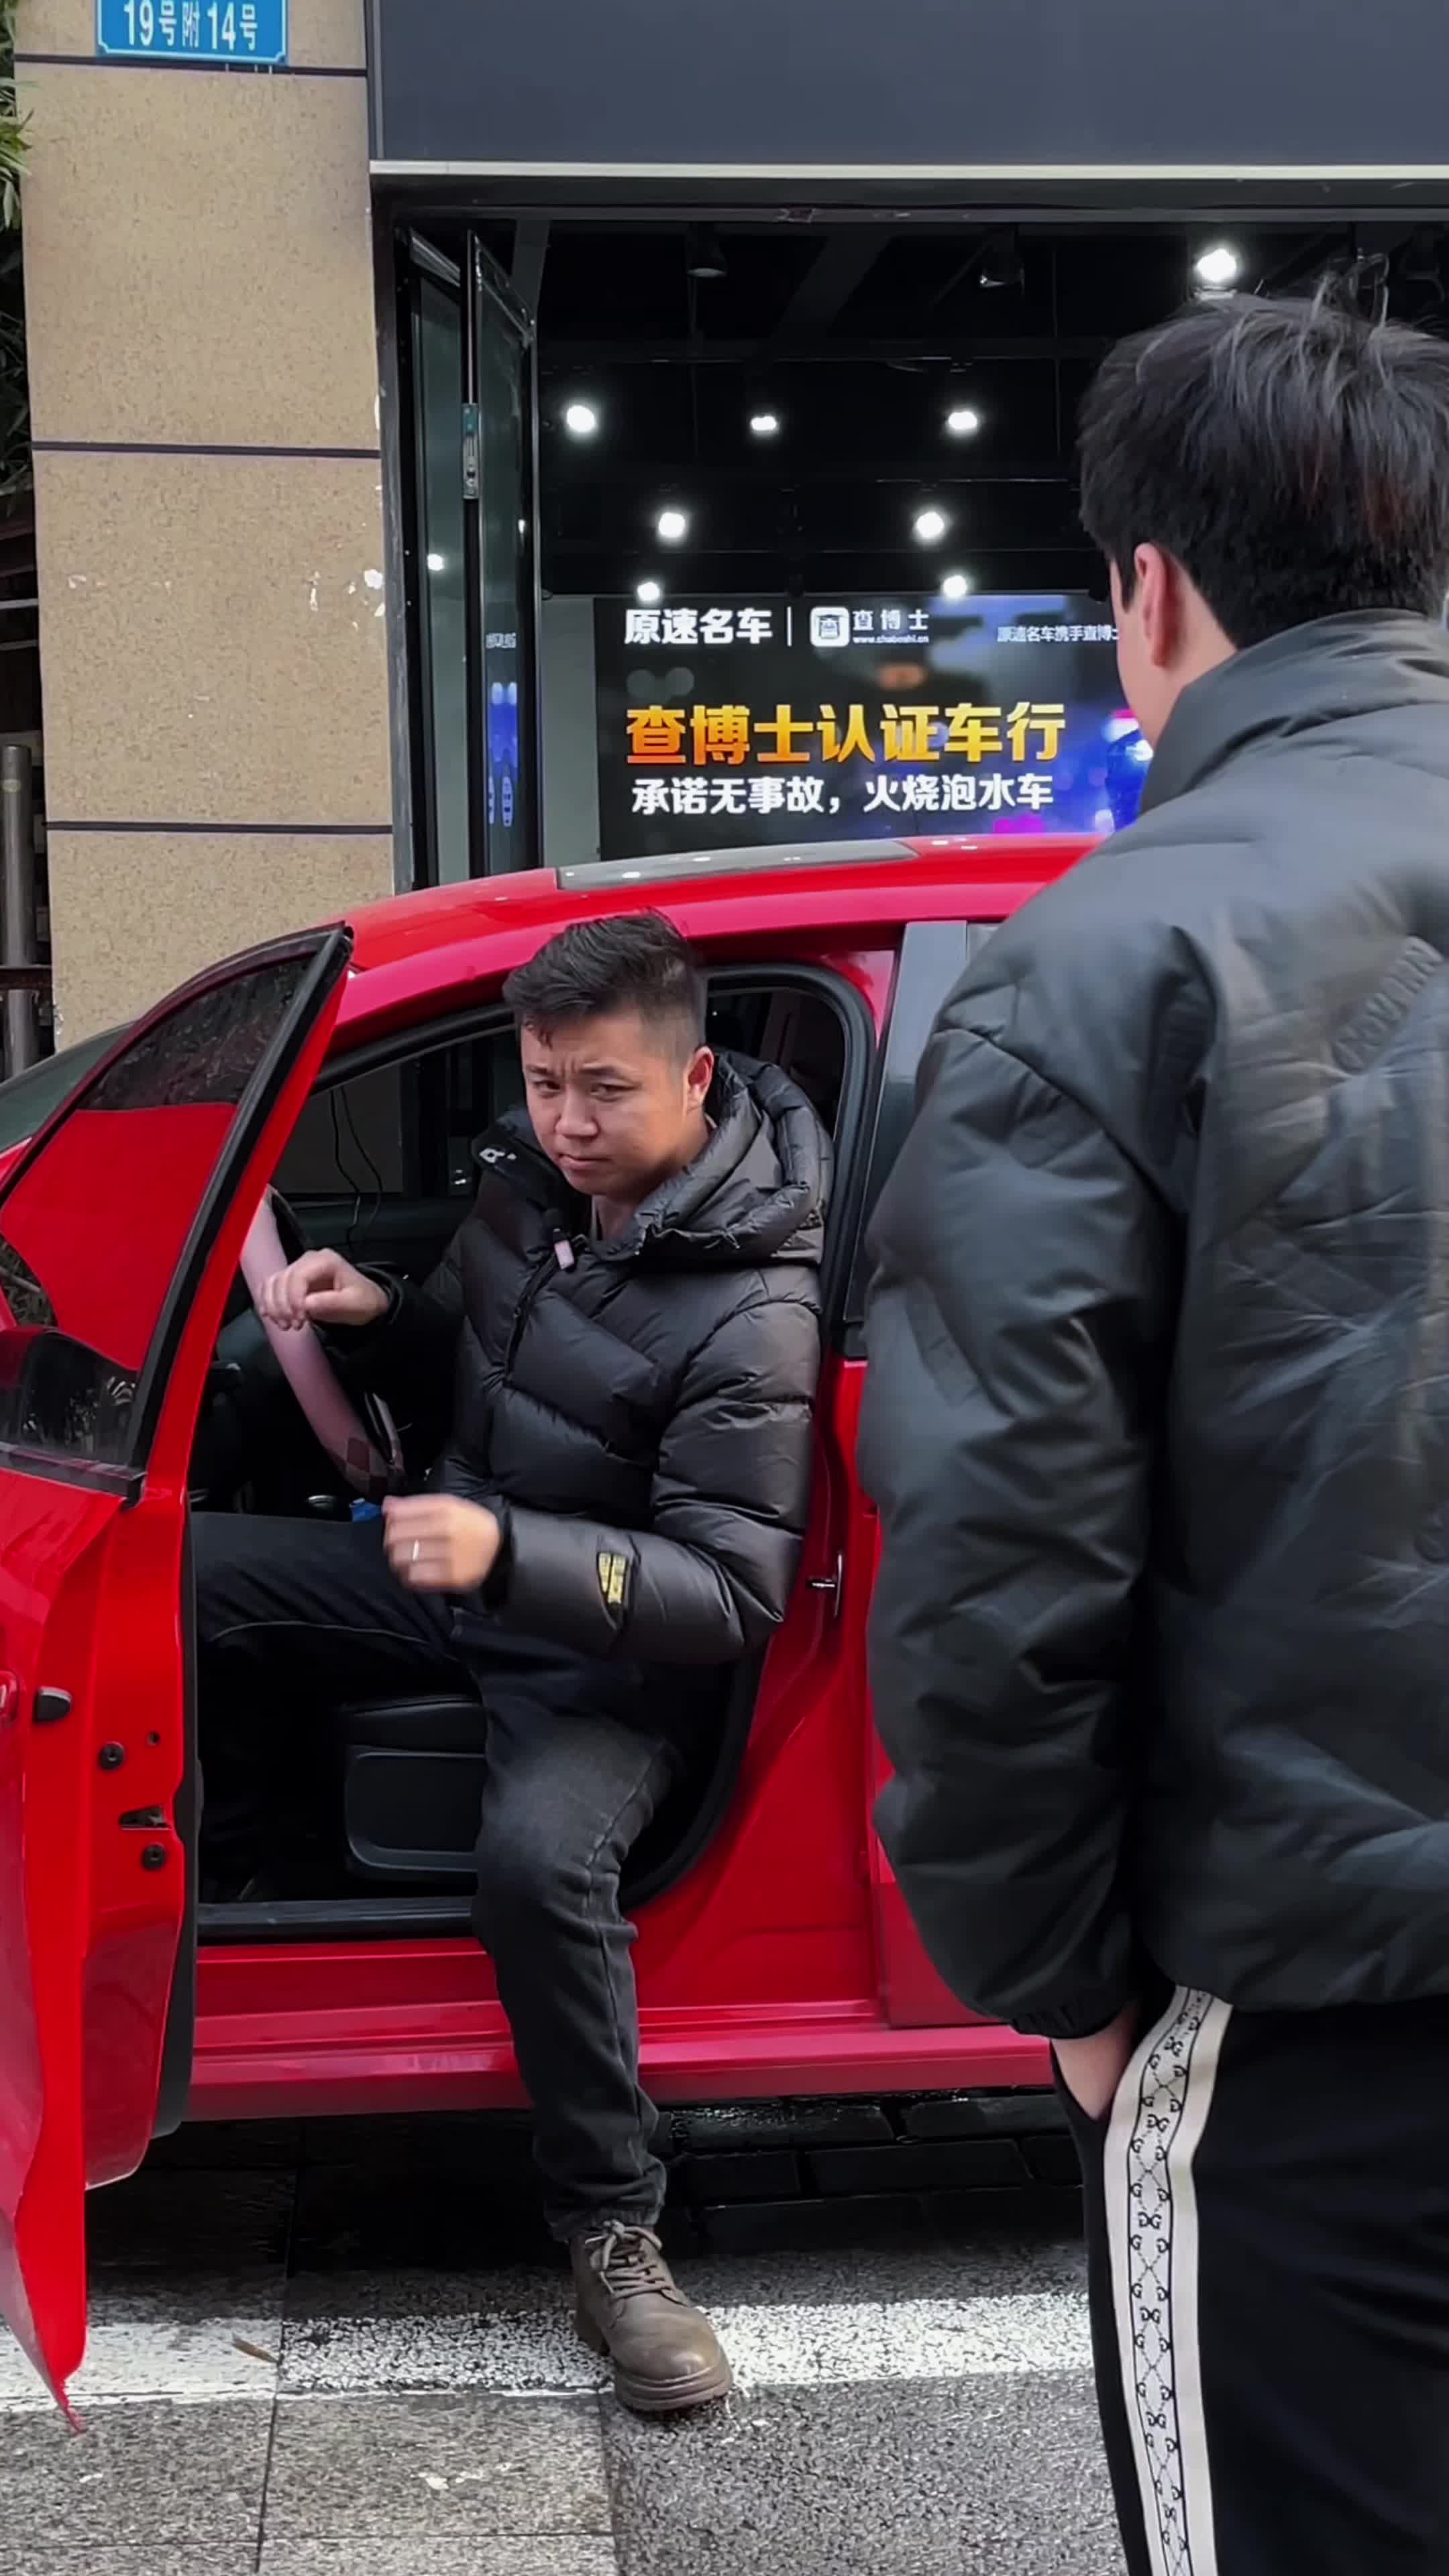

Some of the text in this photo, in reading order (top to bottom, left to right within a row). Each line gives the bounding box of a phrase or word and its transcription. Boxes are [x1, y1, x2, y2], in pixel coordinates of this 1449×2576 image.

[123, 0, 258, 50] 19号附14号
[625, 607, 772, 644] 原速名车
[853, 609, 929, 631] 查博士
[627, 702, 1065, 765] 查博士认证车行
